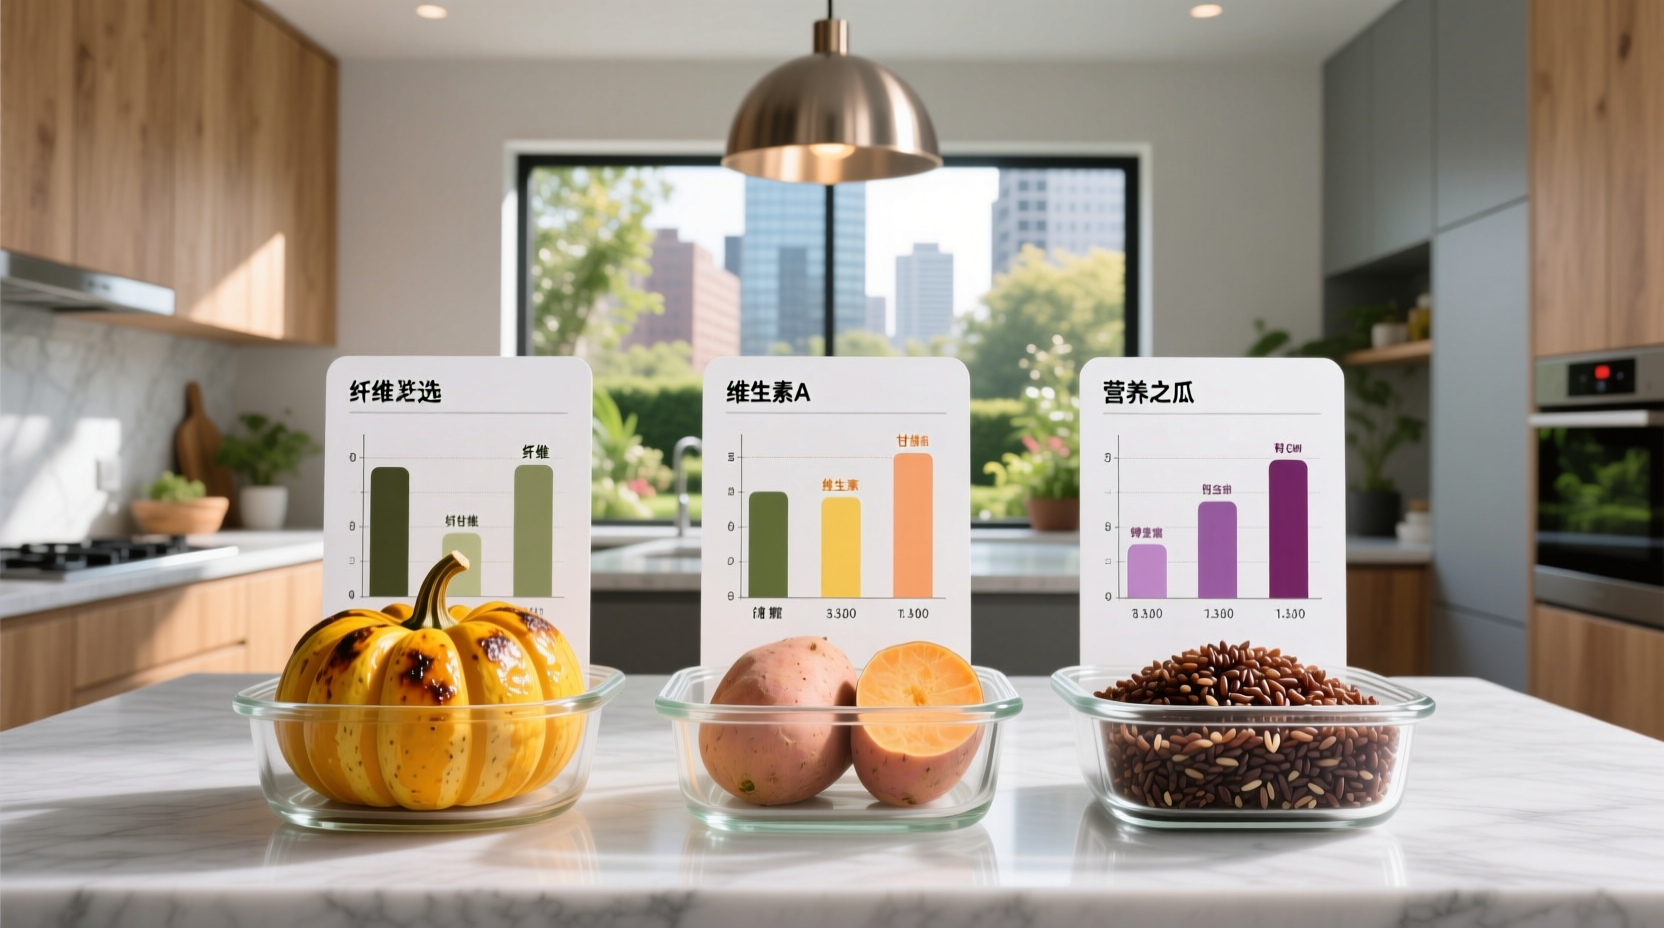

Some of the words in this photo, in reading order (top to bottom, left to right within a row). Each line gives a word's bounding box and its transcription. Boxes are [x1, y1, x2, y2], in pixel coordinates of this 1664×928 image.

[726, 379, 812, 404] 维生素A
[1103, 379, 1195, 405] 营养之瓜
